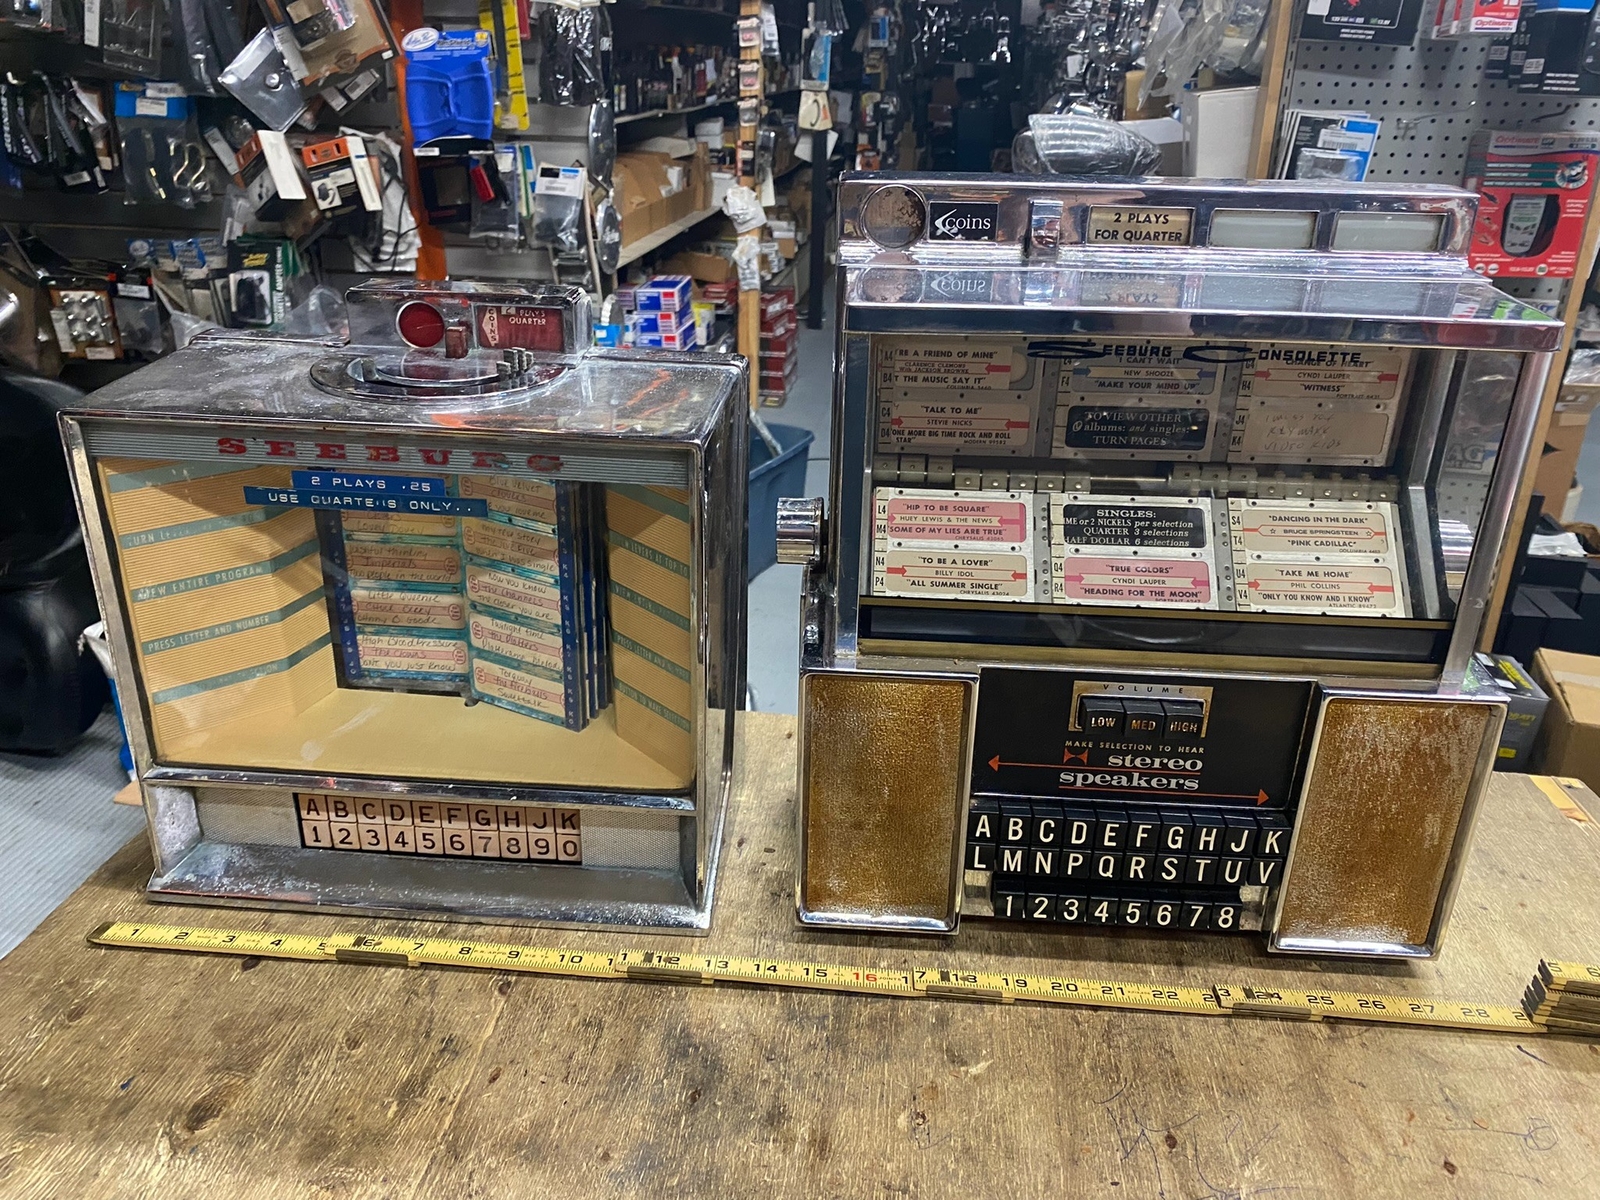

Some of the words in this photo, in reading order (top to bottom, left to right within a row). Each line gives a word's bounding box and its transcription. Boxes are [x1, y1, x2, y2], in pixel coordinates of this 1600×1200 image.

[946, 214, 991, 230] coins
[1114, 212, 1122, 222] 2
[1128, 213, 1170, 225] PLAYS
[1095, 229, 1119, 241] FOR
[1123, 230, 1183, 243] QUARTER
[1129, 382, 1152, 390] YOUR
[1156, 382, 1180, 390] MIND
[1084, 412, 1101, 421] TO
[1105, 412, 1139, 421] VIEW
[1139, 413, 1182, 422] OTHER
[1084, 422, 1125, 432] albums:
[1129, 424, 1147, 432] and
[1149, 424, 1190, 435] singles:
[1093, 436, 1129, 445] TURN
[1130, 437, 1168, 446] PAGES
[312, 476, 321, 487] 2
[332, 476, 387, 490] PLAYS
[268, 492, 300, 504] USE
[1097, 510, 1156, 518] SINGLES:
[1143, 529, 1189, 537] selections
[1091, 537, 1130, 545] DOLLAR
[1144, 539, 1189, 547] selections
[1275, 569, 1302, 577] "TAKE
[173, 577, 209, 593] ENTIRE
[906, 579, 926, 587] "ALL
[970, 582, 1003, 590] SINGLE"
[1080, 587, 1124, 596] "HEADING
[1258, 592, 1280, 601] "ONLY
[148, 638, 176, 652] PRESS
[180, 630, 210, 644] LETTER
[215, 624, 232, 636] AND
[236, 615, 270, 631] NUMBER
[1103, 684, 1185, 694] VOLUME
[1091, 717, 1116, 728] LOW
[1131, 720, 1156, 731] MED
[1170, 721, 1198, 733] HIGH
[1065, 740, 1094, 748] MAKE
[1099, 742, 1154, 750] SELECTION
[1178, 746, 1204, 754] HEAR
[1108, 753, 1204, 770] stereo
[1059, 771, 1200, 791] speakers
[975, 815, 991, 838] A
[1008, 818, 1023, 840] B
[1039, 820, 1055, 843] C
[1071, 822, 1087, 844] D
[1104, 824, 1120, 847] E
[1136, 825, 1152, 847] F
[1167, 826, 1184, 849] G
[1199, 828, 1217, 851] H
[1231, 830, 1249, 852] J
[1265, 831, 1283, 854] K
[174, 931, 189, 941] 2
[412, 942, 424, 952] 7
[559, 953, 583, 964] 10
[754, 963, 778, 974] 14
[853, 972, 878, 983] 16
[1051, 982, 1078, 992] 20
[1306, 995, 1333, 1006] 25
